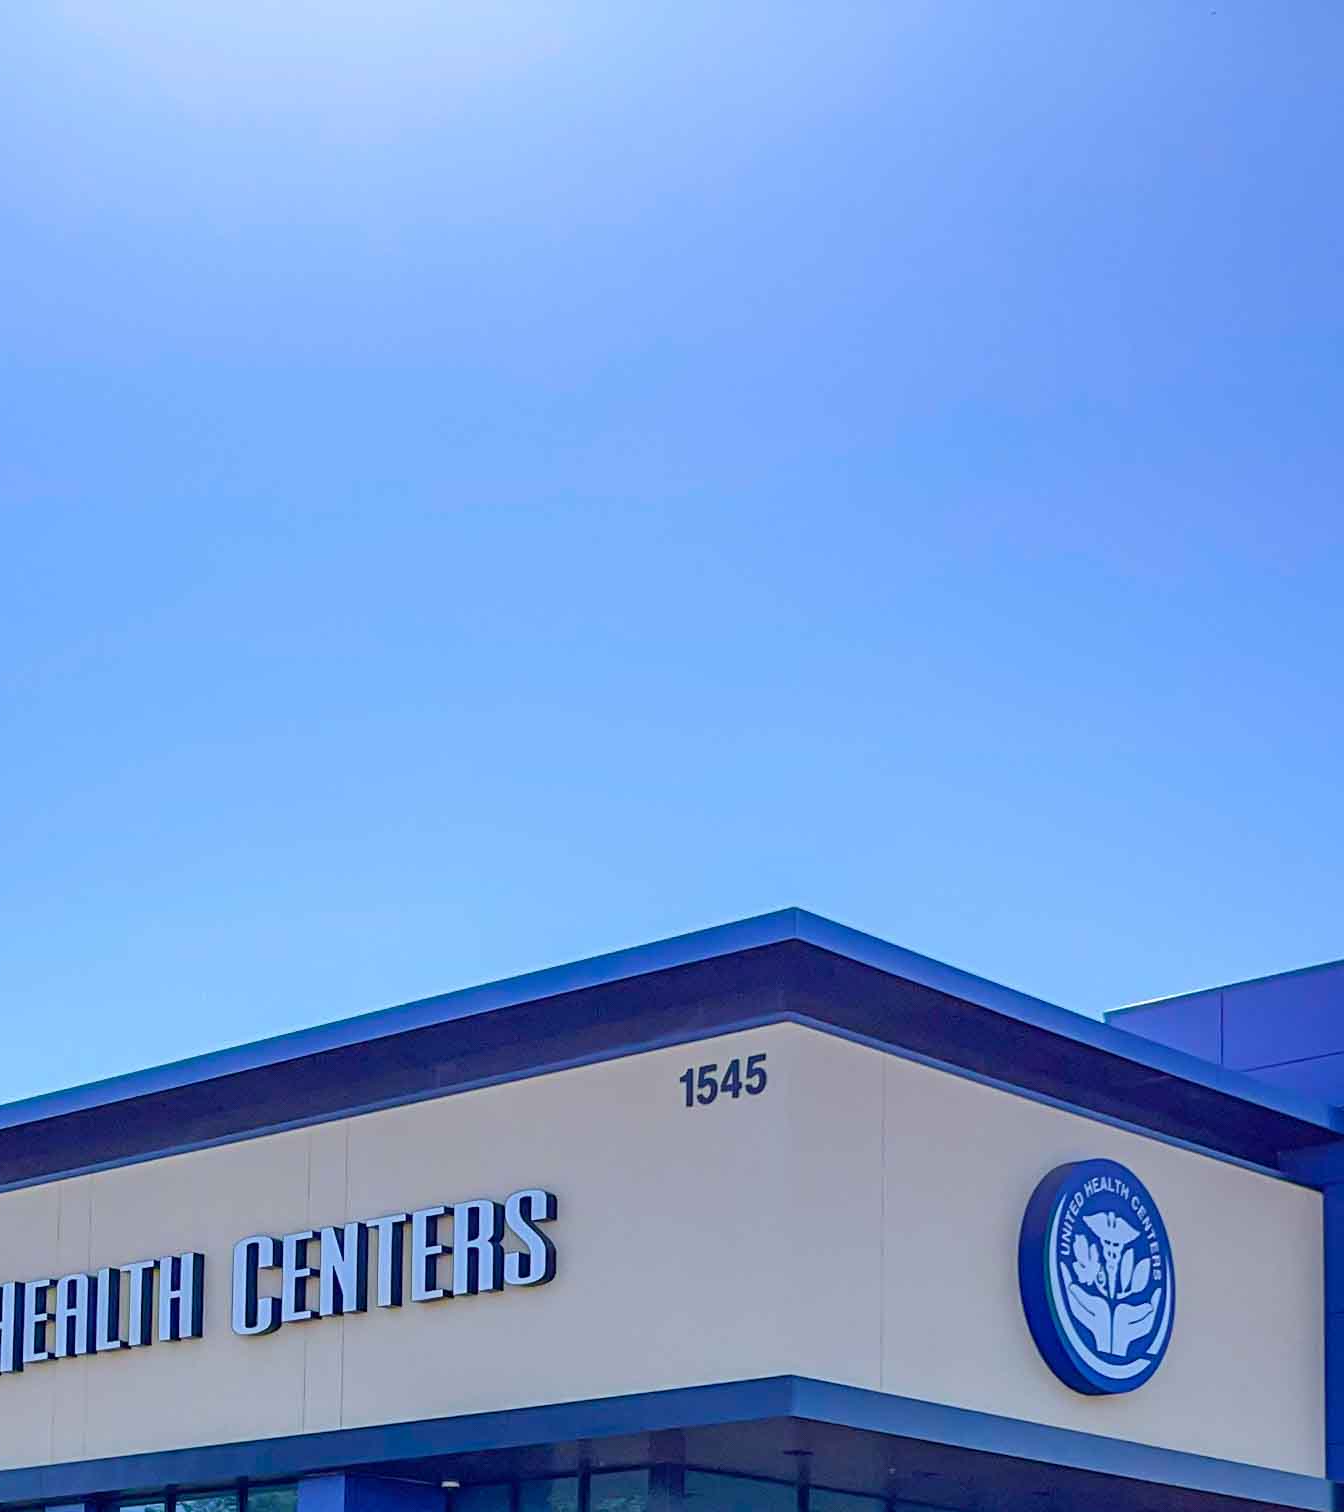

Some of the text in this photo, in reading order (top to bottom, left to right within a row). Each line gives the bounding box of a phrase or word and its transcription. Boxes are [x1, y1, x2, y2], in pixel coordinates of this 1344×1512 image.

[679, 1053, 767, 1108] 1545
[1060, 1191, 1084, 1256] UNITED
[1083, 1175, 1129, 1200] HEALTH
[231, 1187, 558, 1336] CENTERS
